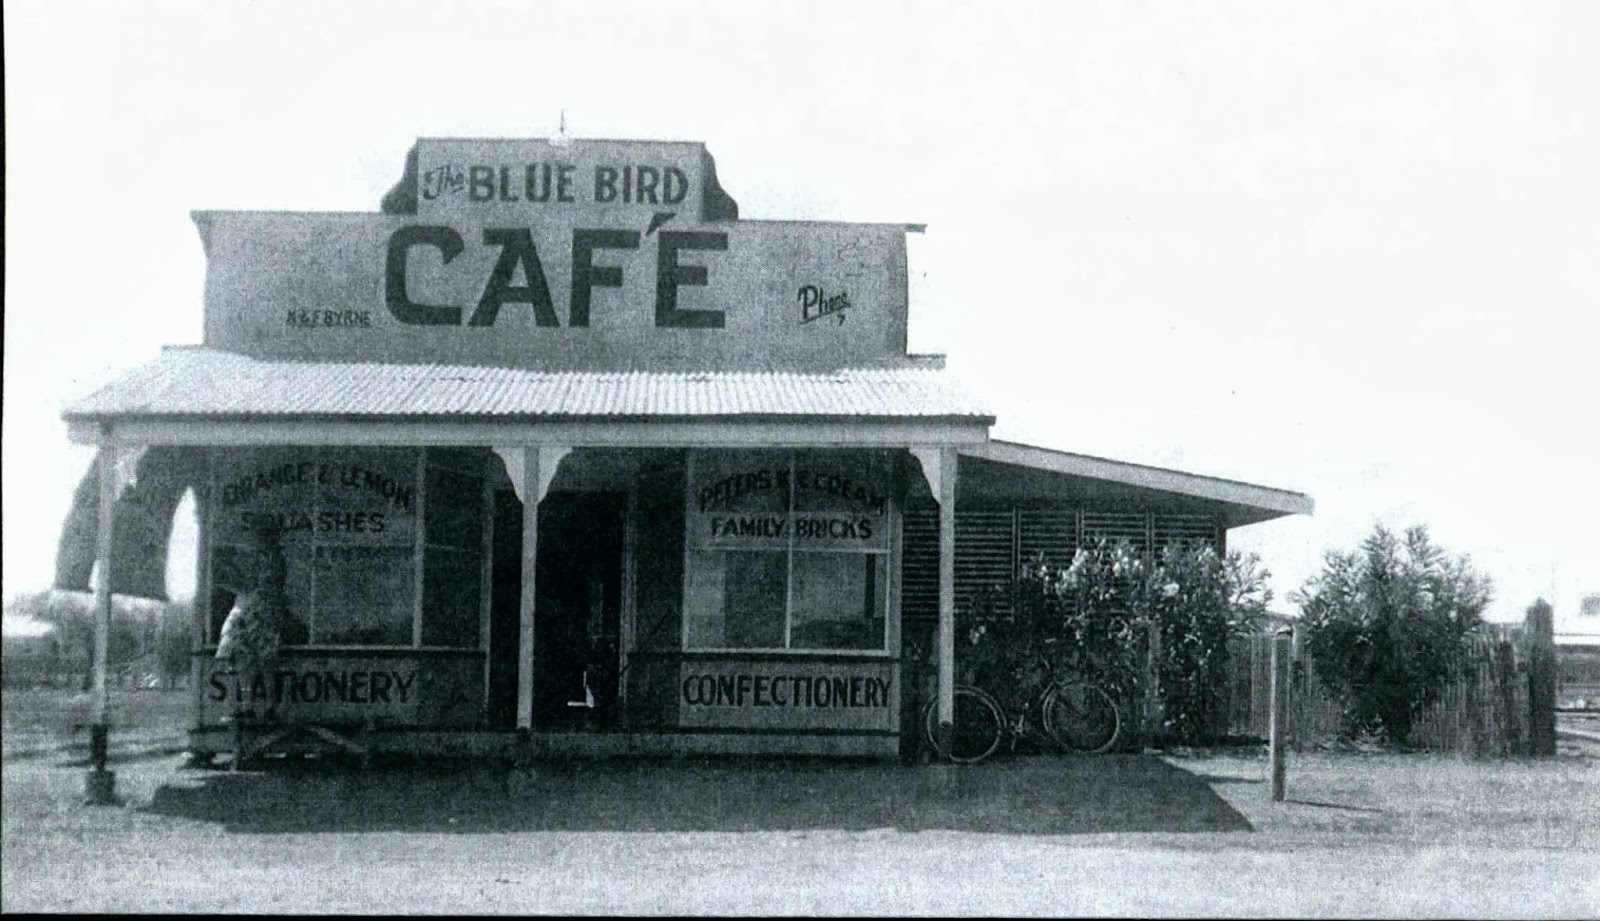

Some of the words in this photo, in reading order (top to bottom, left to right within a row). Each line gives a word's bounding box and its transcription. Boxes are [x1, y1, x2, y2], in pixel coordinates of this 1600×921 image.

[422, 165, 465, 200] The
[469, 163, 577, 203] BLUE
[594, 164, 689, 205] BIRD
[385, 213, 728, 328] CAFÉ
[223, 461, 313, 506] ORANGE
[340, 464, 411, 508] LEMON
[700, 470, 772, 513] PETERS
[814, 471, 886, 516] CREAM
[711, 517, 786, 538] FAMILY
[795, 517, 873, 540] BRICKS
[210, 670, 416, 703] STATIONERY
[683, 674, 892, 707] CONFECTIONERY
